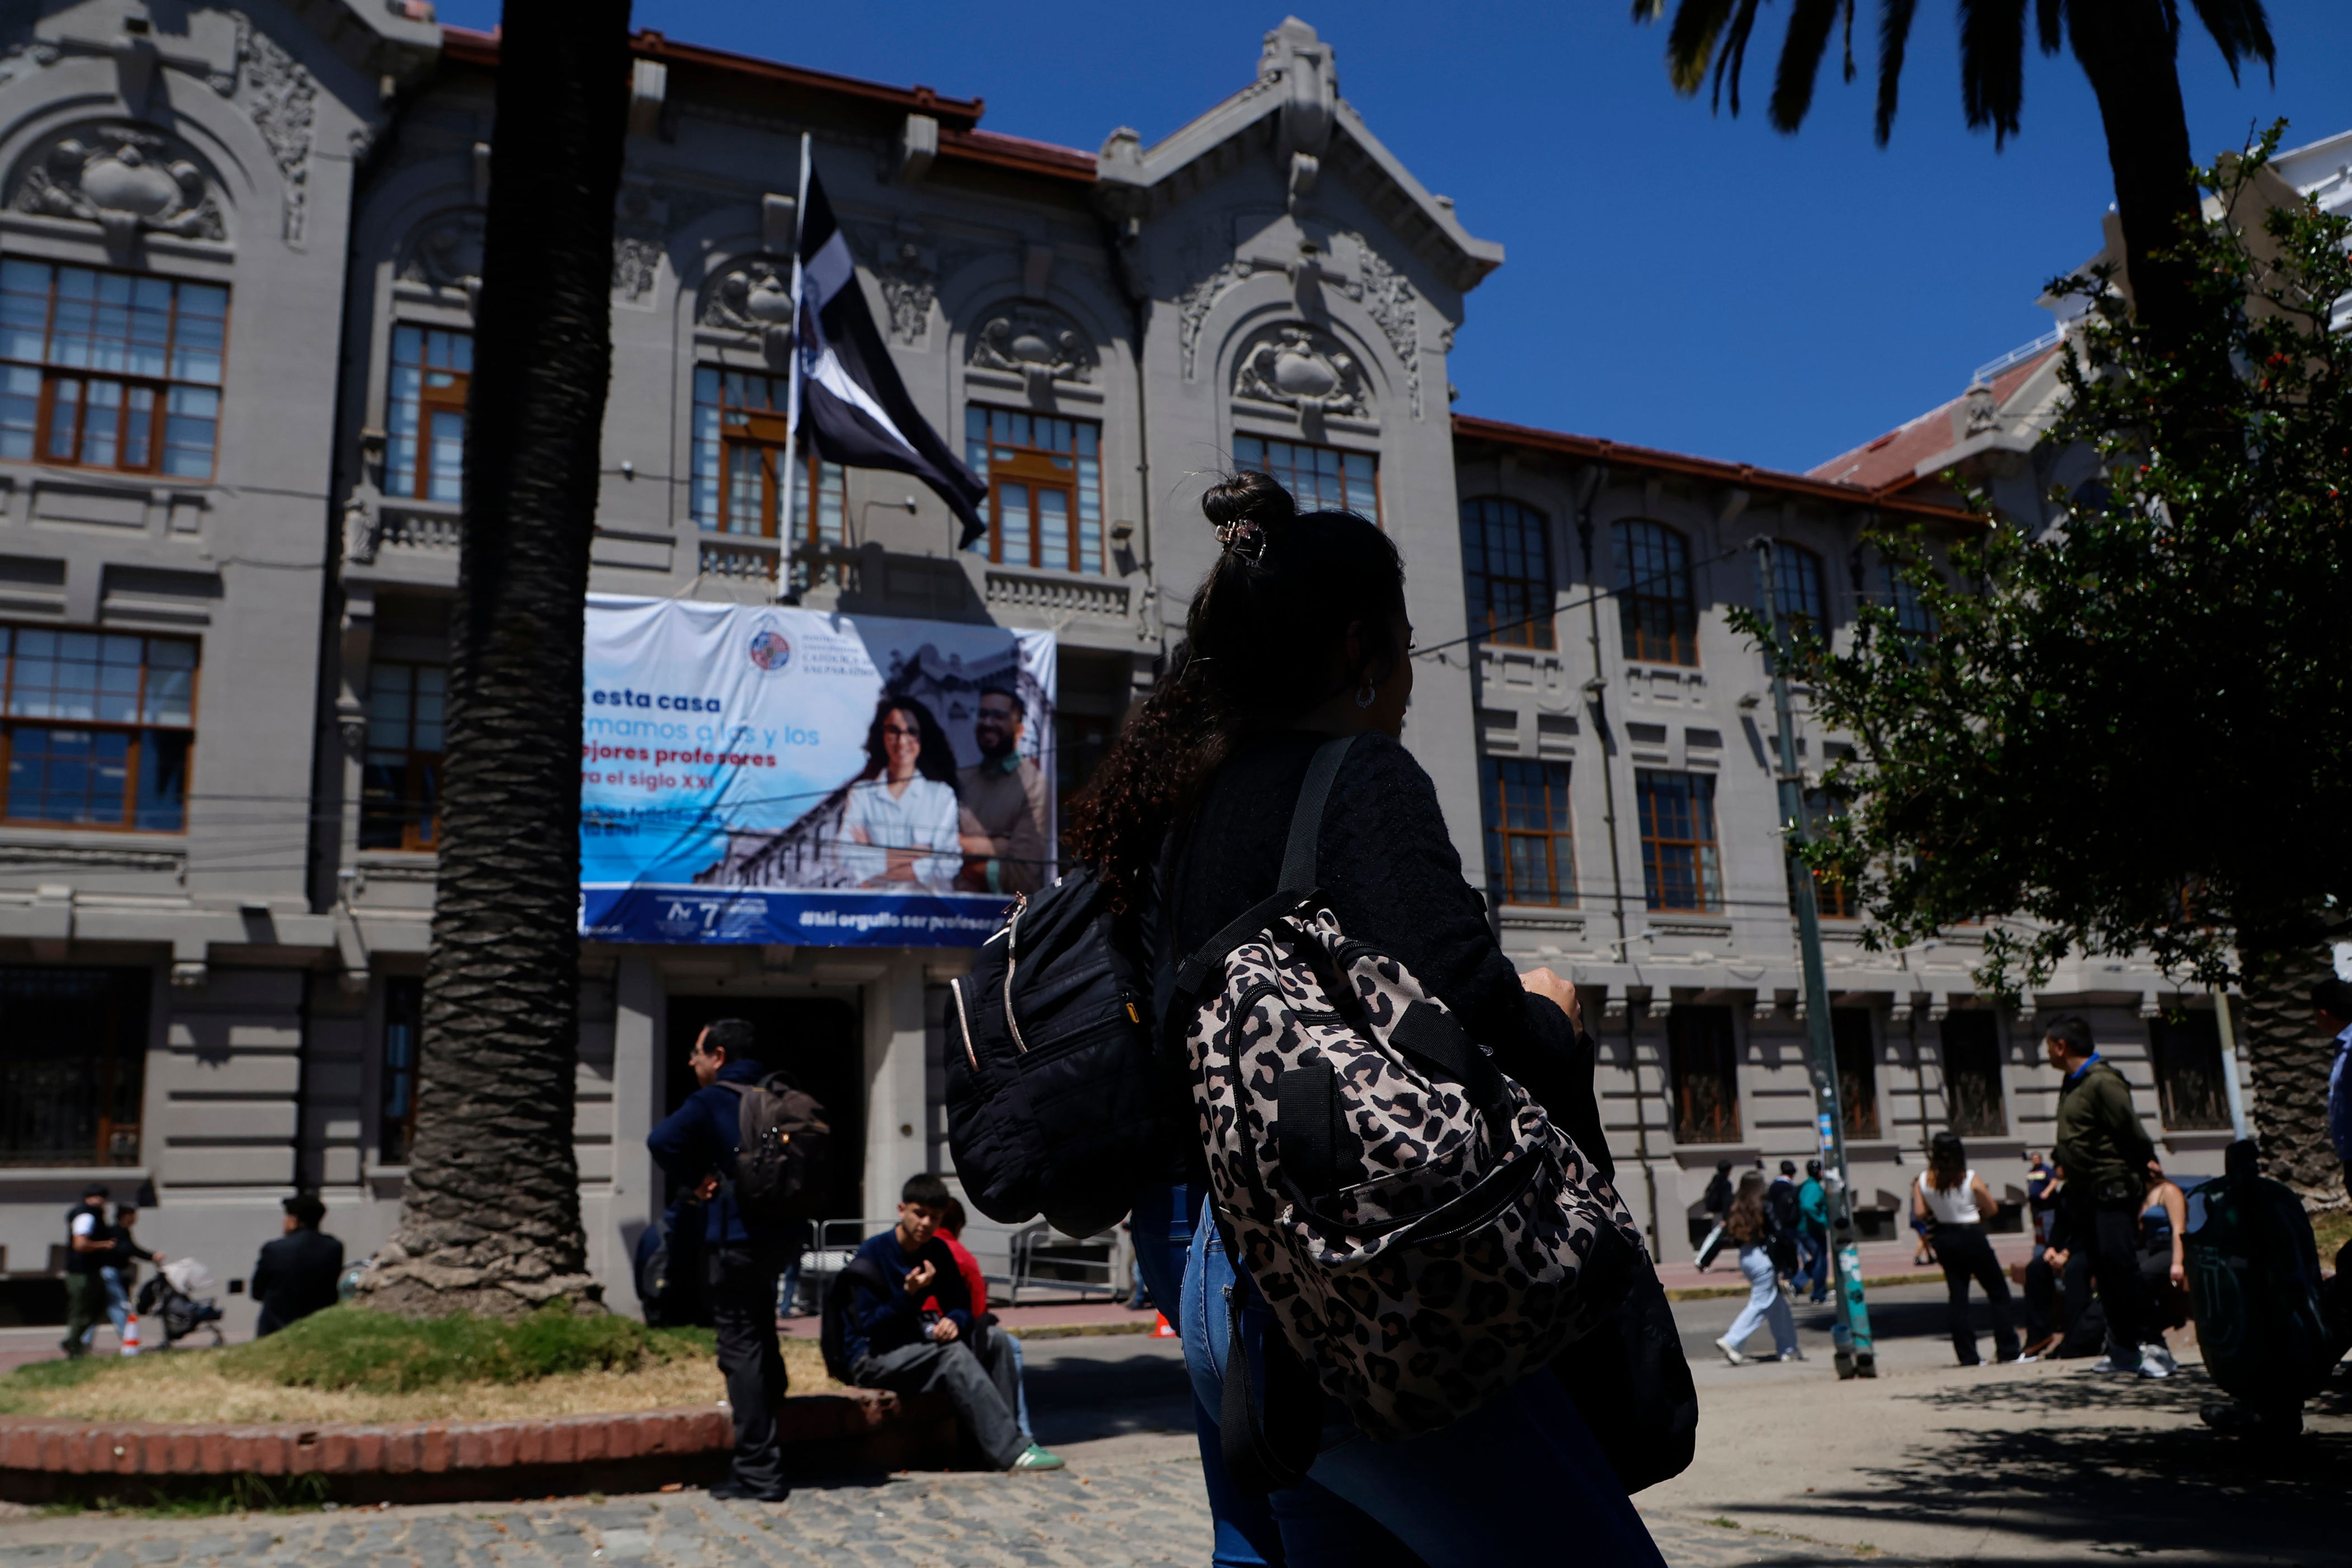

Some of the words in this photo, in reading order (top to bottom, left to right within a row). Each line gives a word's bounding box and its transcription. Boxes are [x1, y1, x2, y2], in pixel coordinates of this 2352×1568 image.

[593, 688, 650, 708] esta
[658, 695, 721, 713] casa
[587, 717, 688, 740] mamos
[696, 725, 713, 742] a
[721, 722, 755, 744] los
[763, 729, 777, 749] y
[785, 724, 820, 746] los
[655, 747, 777, 768] profesores
[607, 770, 624, 785] el
[630, 770, 677, 792] siglo
[683, 774, 715, 788] XXI
[699, 902, 719, 928] 7
[838, 911, 900, 932] orgullo
[901, 914, 928, 929] ser
